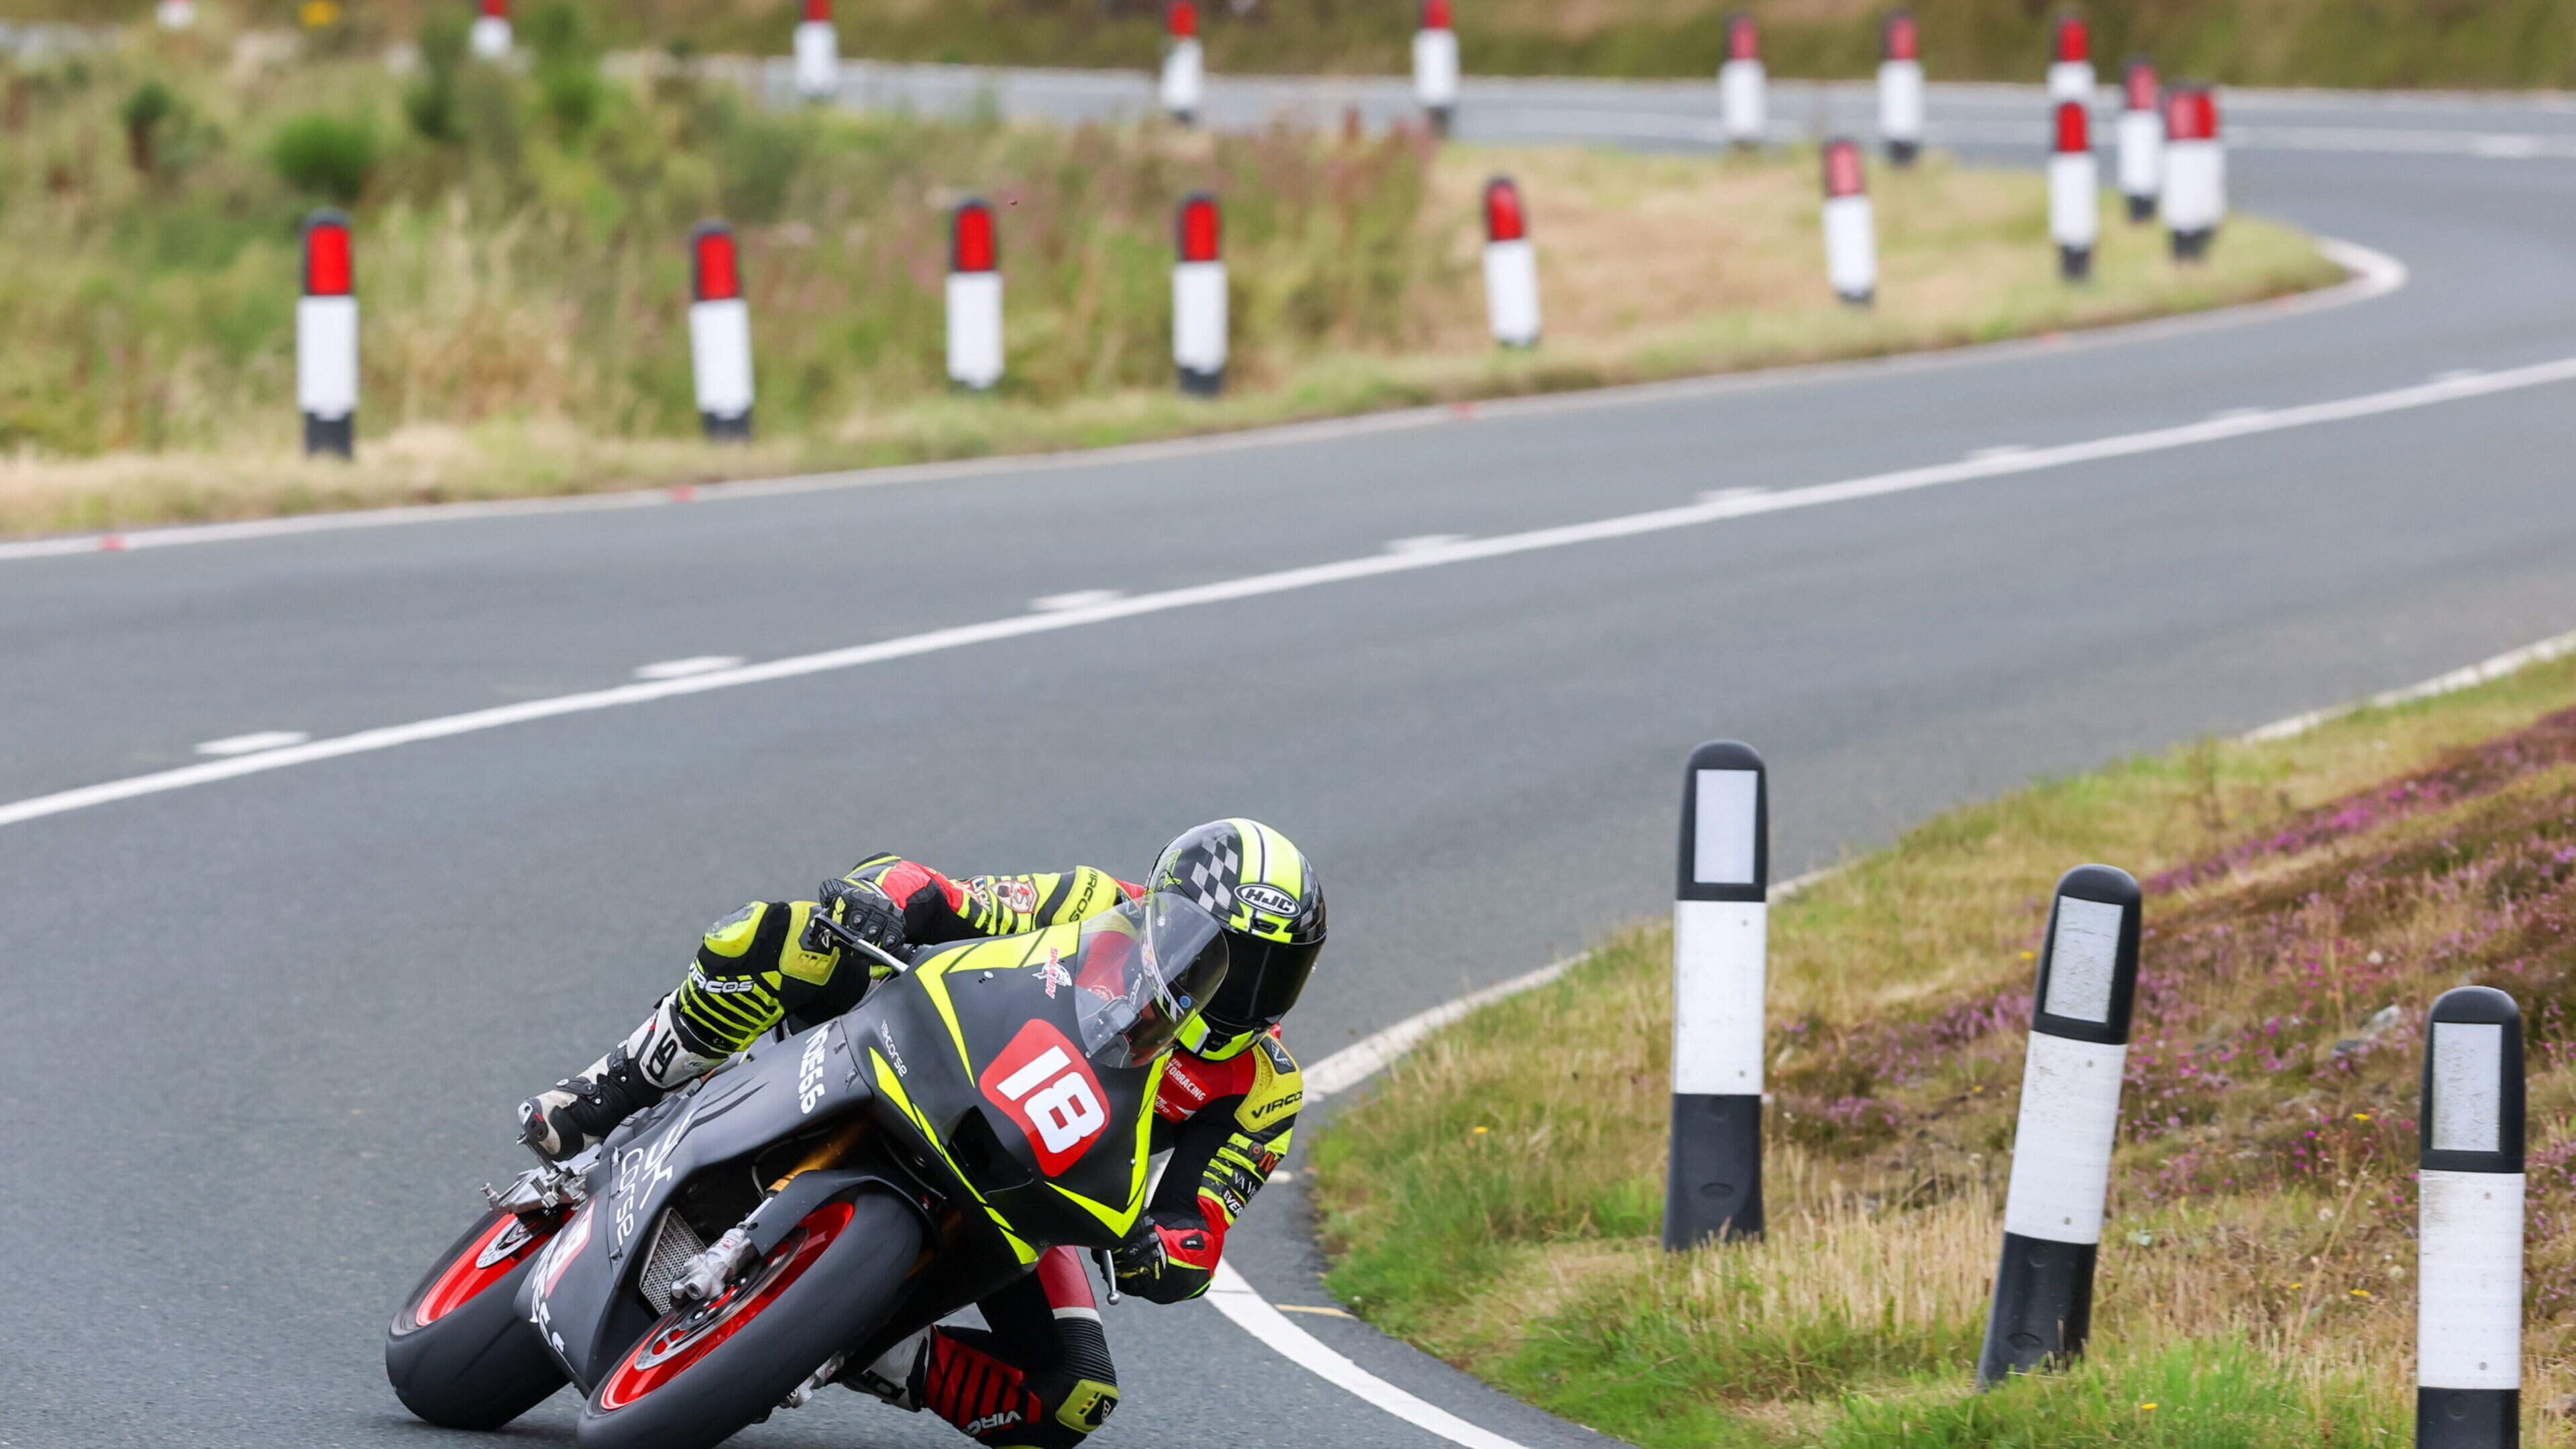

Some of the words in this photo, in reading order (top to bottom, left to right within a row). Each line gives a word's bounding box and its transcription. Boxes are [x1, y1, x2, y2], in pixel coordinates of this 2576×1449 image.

[1245, 889, 1293, 912] HJC
[996, 1045, 1105, 1153] 18
[1251, 1091, 1303, 1118] VIRCO
[616, 1147, 643, 1246] corse
[962, 1411, 1021, 1436] VIRC
